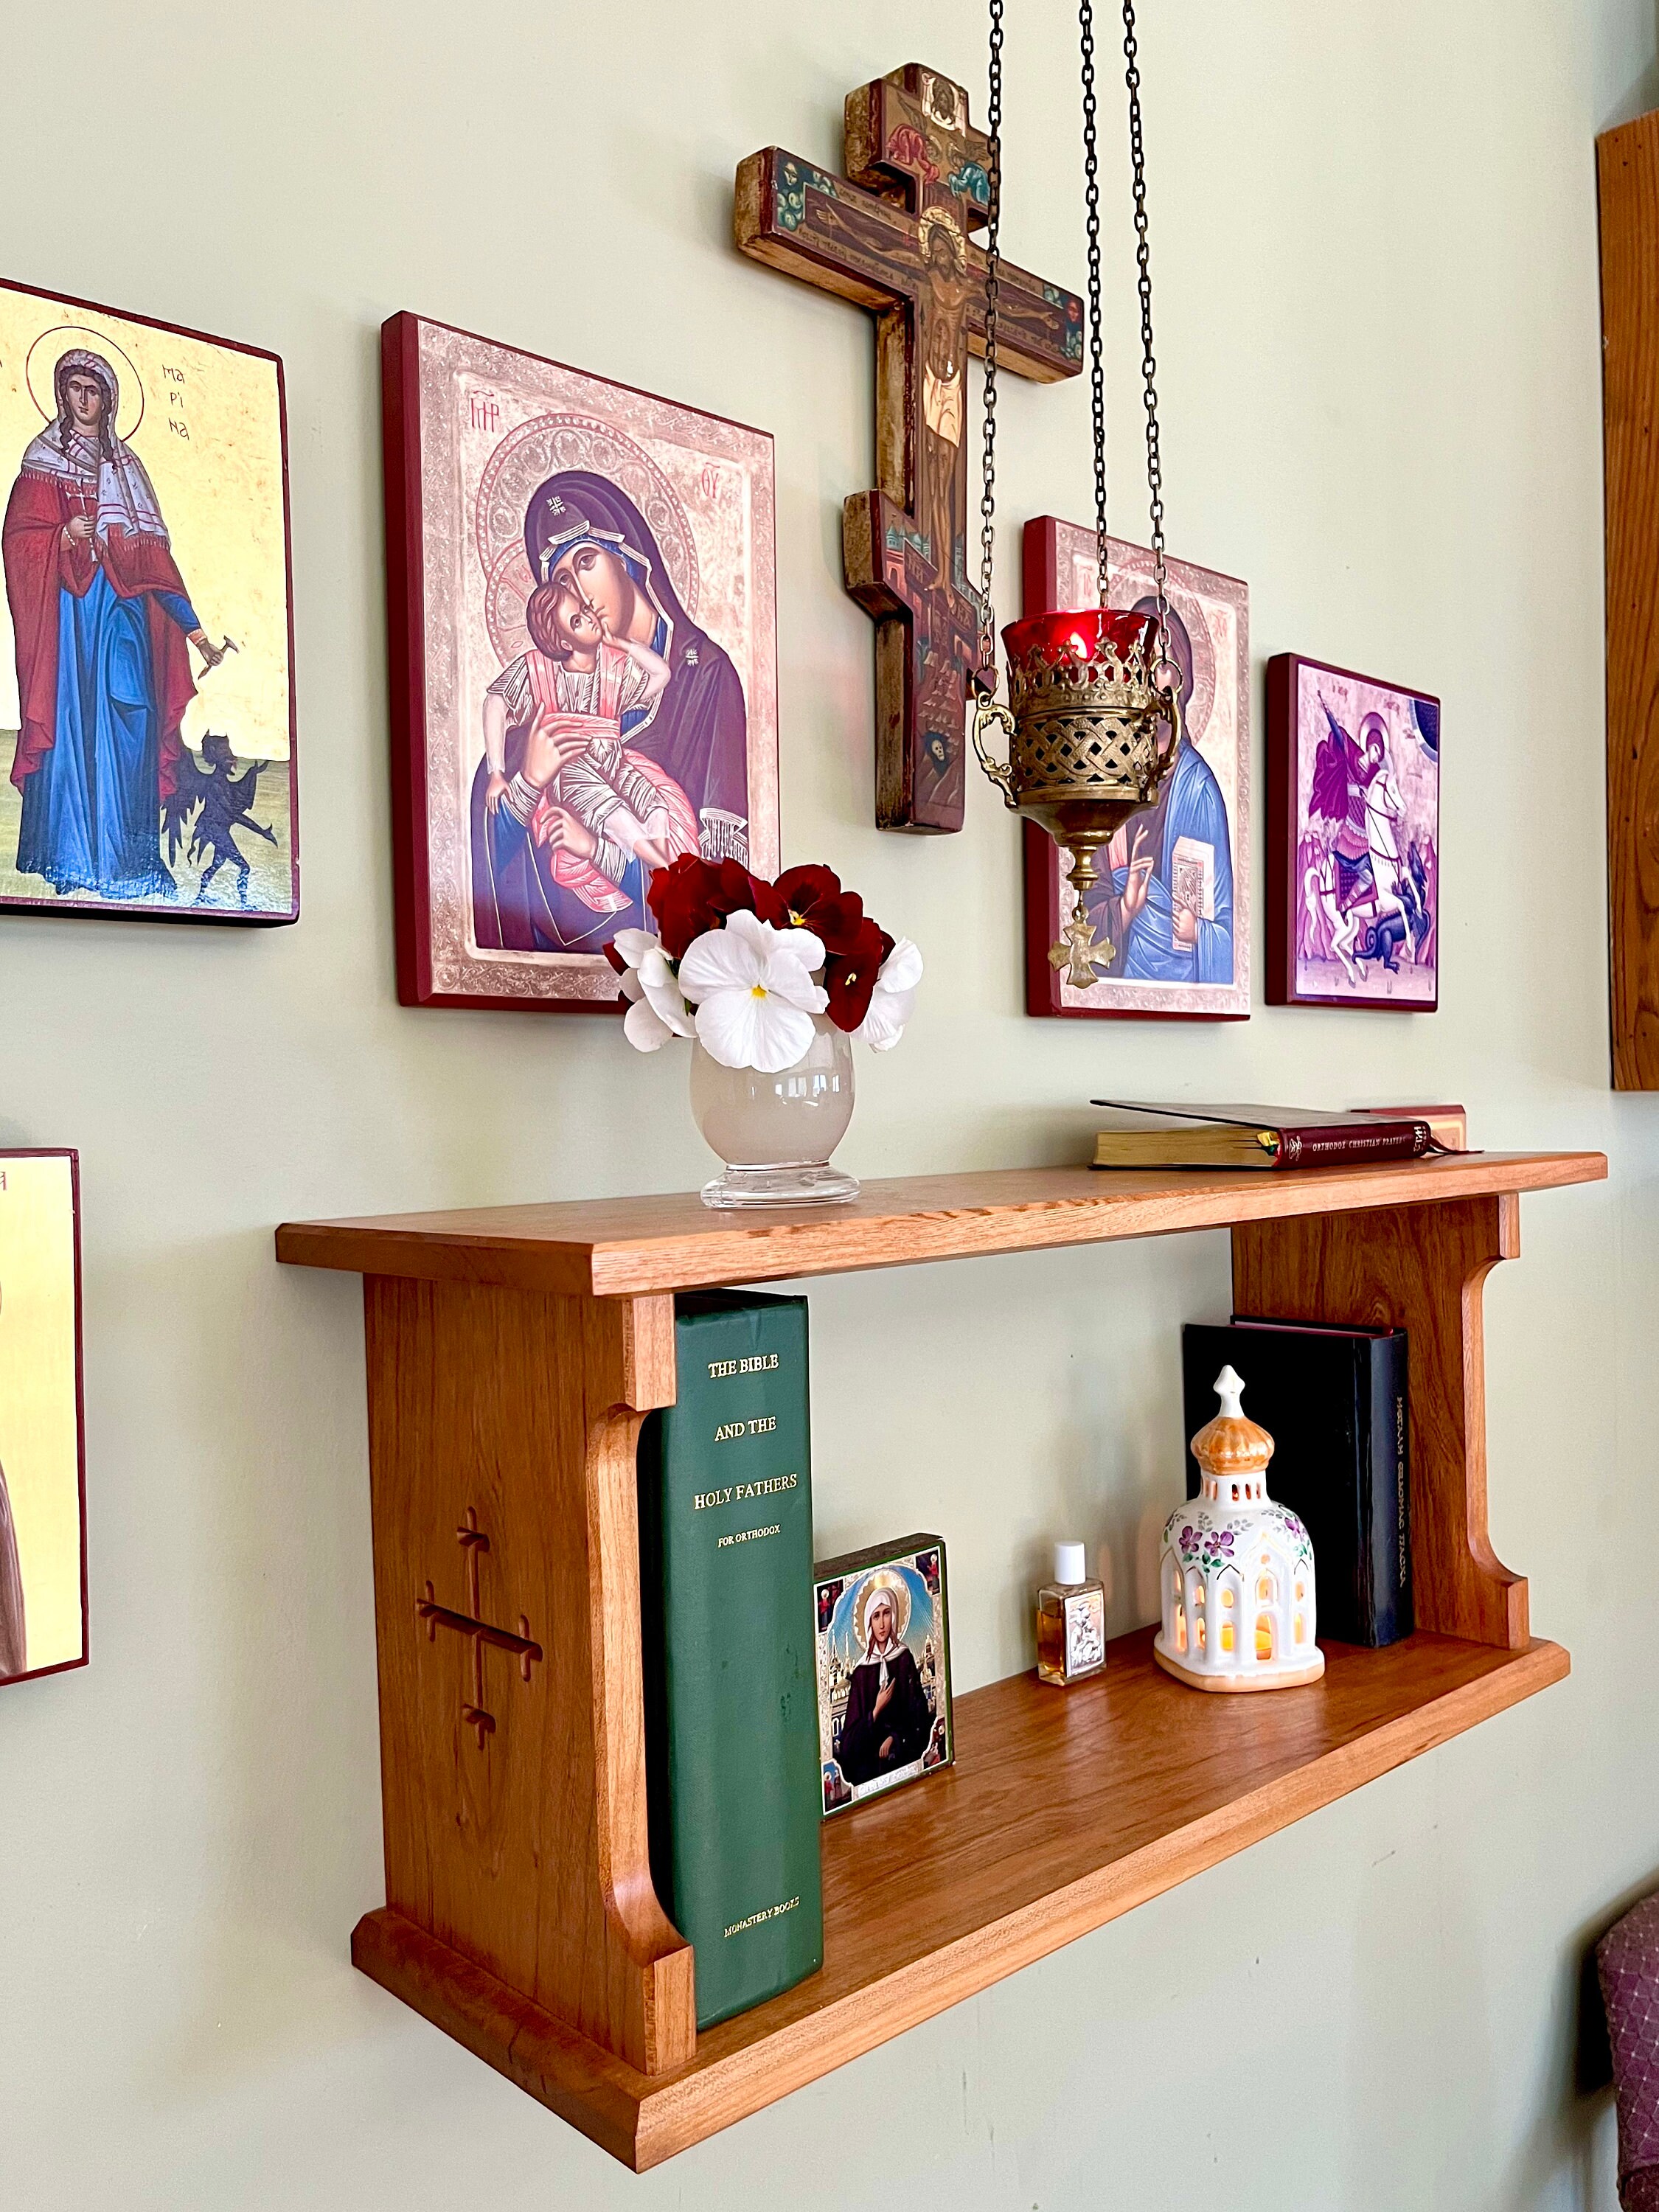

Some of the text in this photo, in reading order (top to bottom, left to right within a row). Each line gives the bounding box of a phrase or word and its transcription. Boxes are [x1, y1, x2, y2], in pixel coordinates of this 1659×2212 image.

[1312, 1142, 1346, 1152] ORTHODOX
[1349, 1138, 1380, 1149] CHRISTIAN
[708, 1354, 779, 1379] THE BIBLE
[714, 1416, 776, 1441] AND THE
[694, 1473, 798, 1510] HOLY FATHERS
[717, 1524, 781, 1548] FOR ORTHODOX
[724, 1896, 799, 1938] MONASTERY BOOKS
